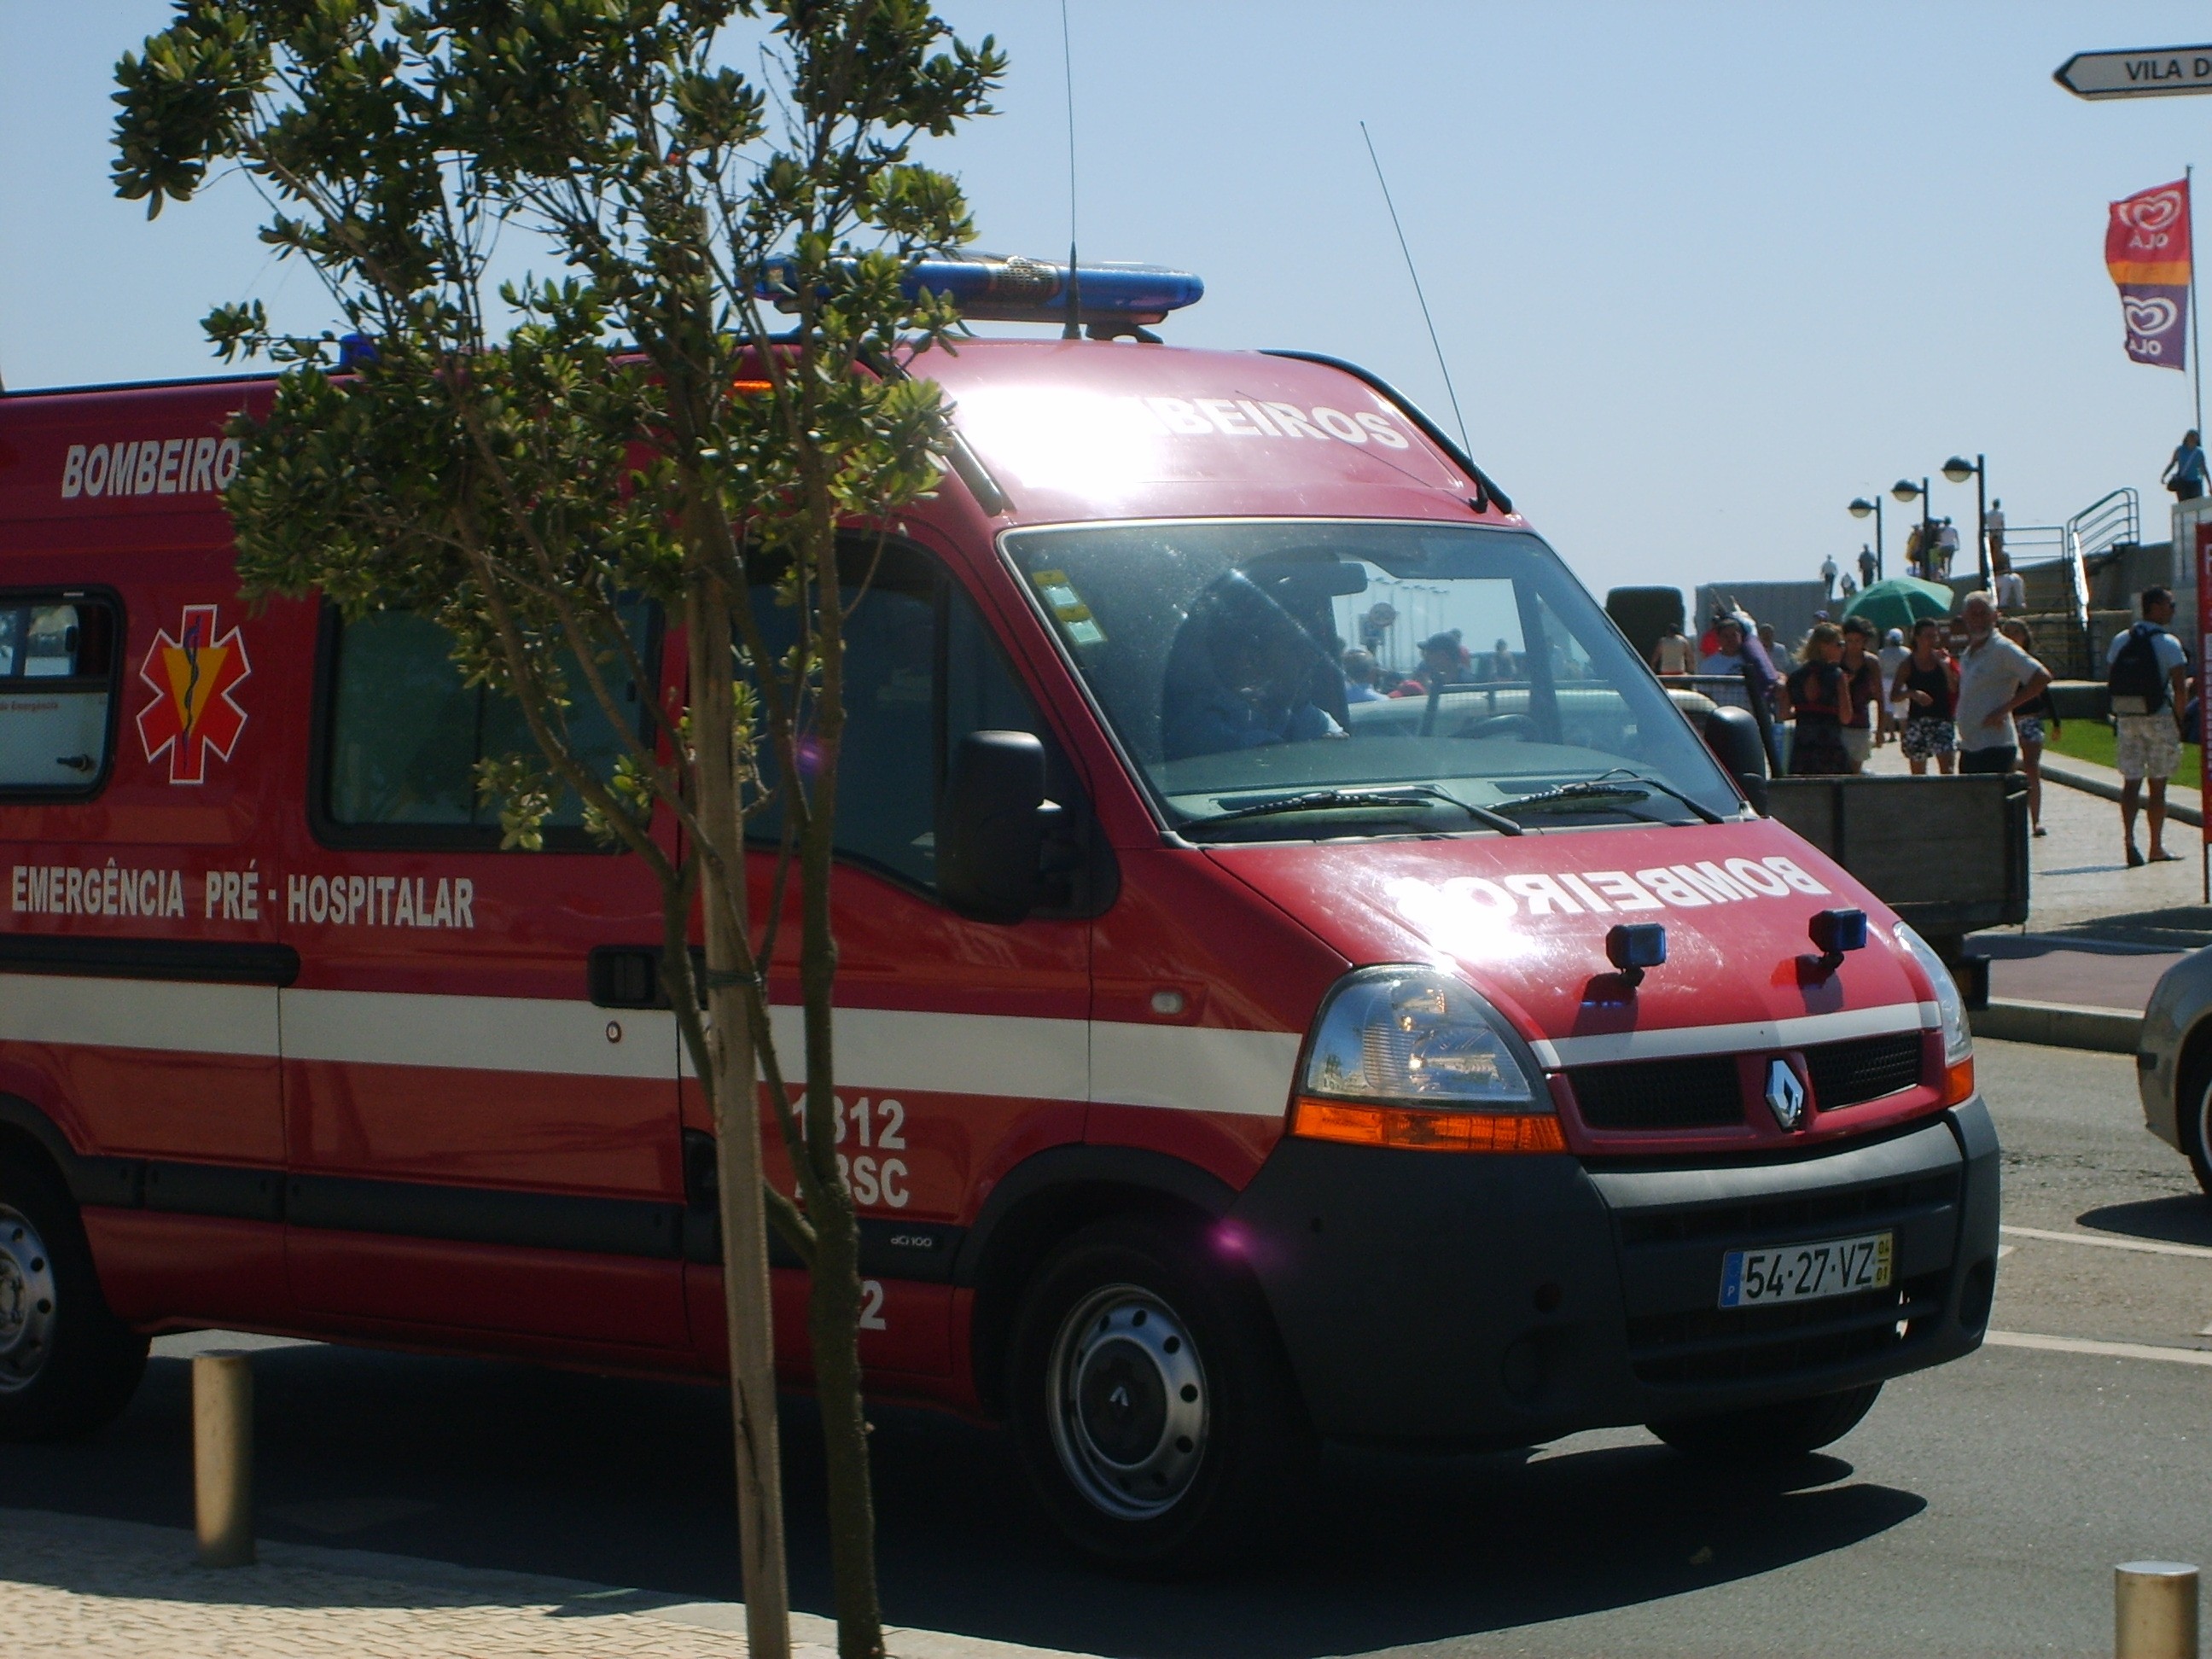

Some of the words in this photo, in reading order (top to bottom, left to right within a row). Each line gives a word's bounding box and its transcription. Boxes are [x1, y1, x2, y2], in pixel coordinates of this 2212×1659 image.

[2125, 59, 2181, 80] VILA
[2194, 57, 2212, 78] D
[1144, 398, 1409, 448] BEIROS
[62, 437, 245, 498] BOMBEIRO
[12, 858, 185, 917] EMERGÊNCIA
[206, 860, 259, 919] PRÉ
[287, 874, 474, 928] HOSPITALAR
[795, 1154, 910, 1208] SC
[1727, 1285, 1736, 1297] P
